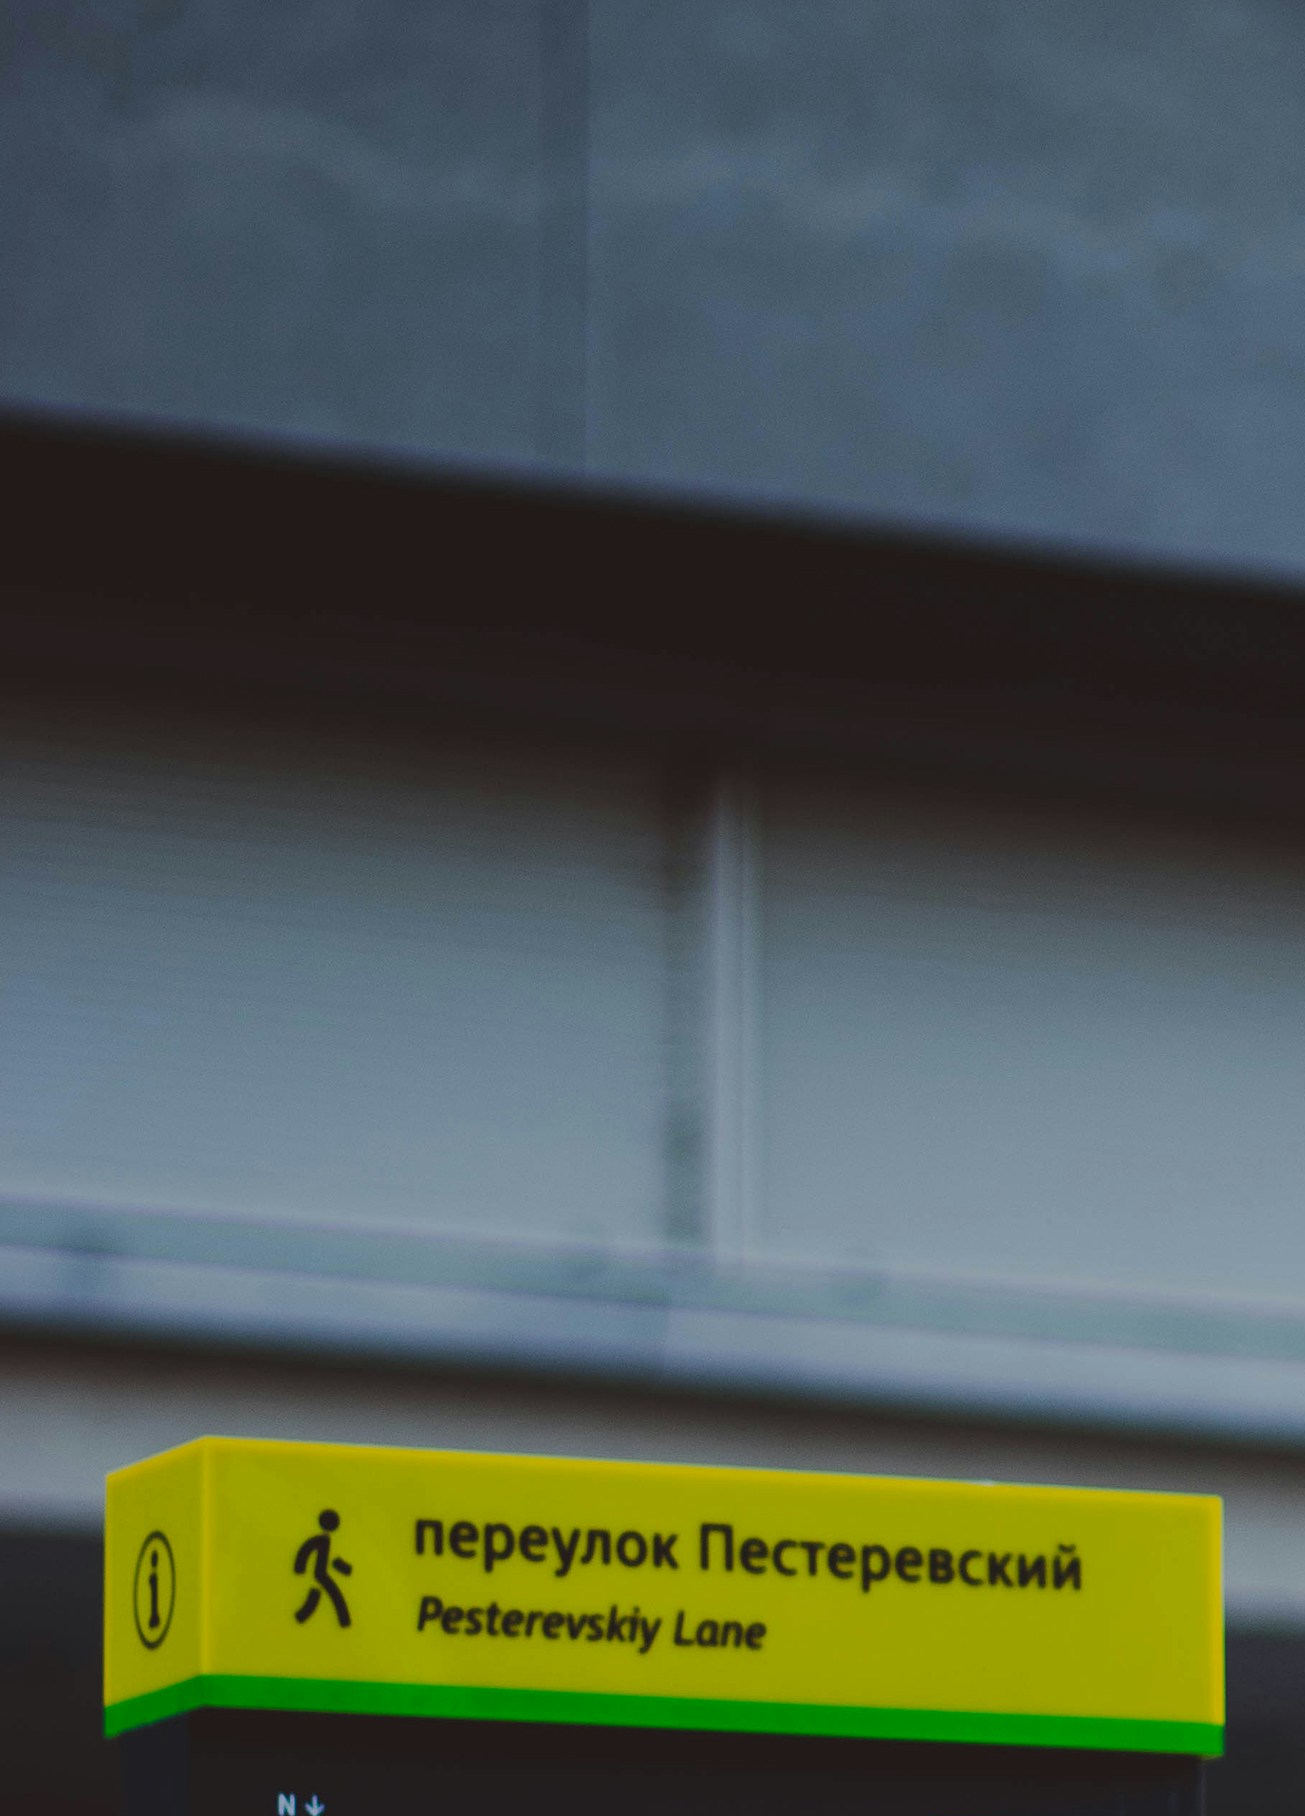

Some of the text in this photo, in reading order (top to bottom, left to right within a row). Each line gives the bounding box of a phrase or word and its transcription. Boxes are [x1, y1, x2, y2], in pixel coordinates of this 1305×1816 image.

[414, 1518, 1082, 1594] переулок Пестеревский
[416, 1595, 767, 1655] Pesterevskiy Lane
[277, 1793, 296, 1816] N
